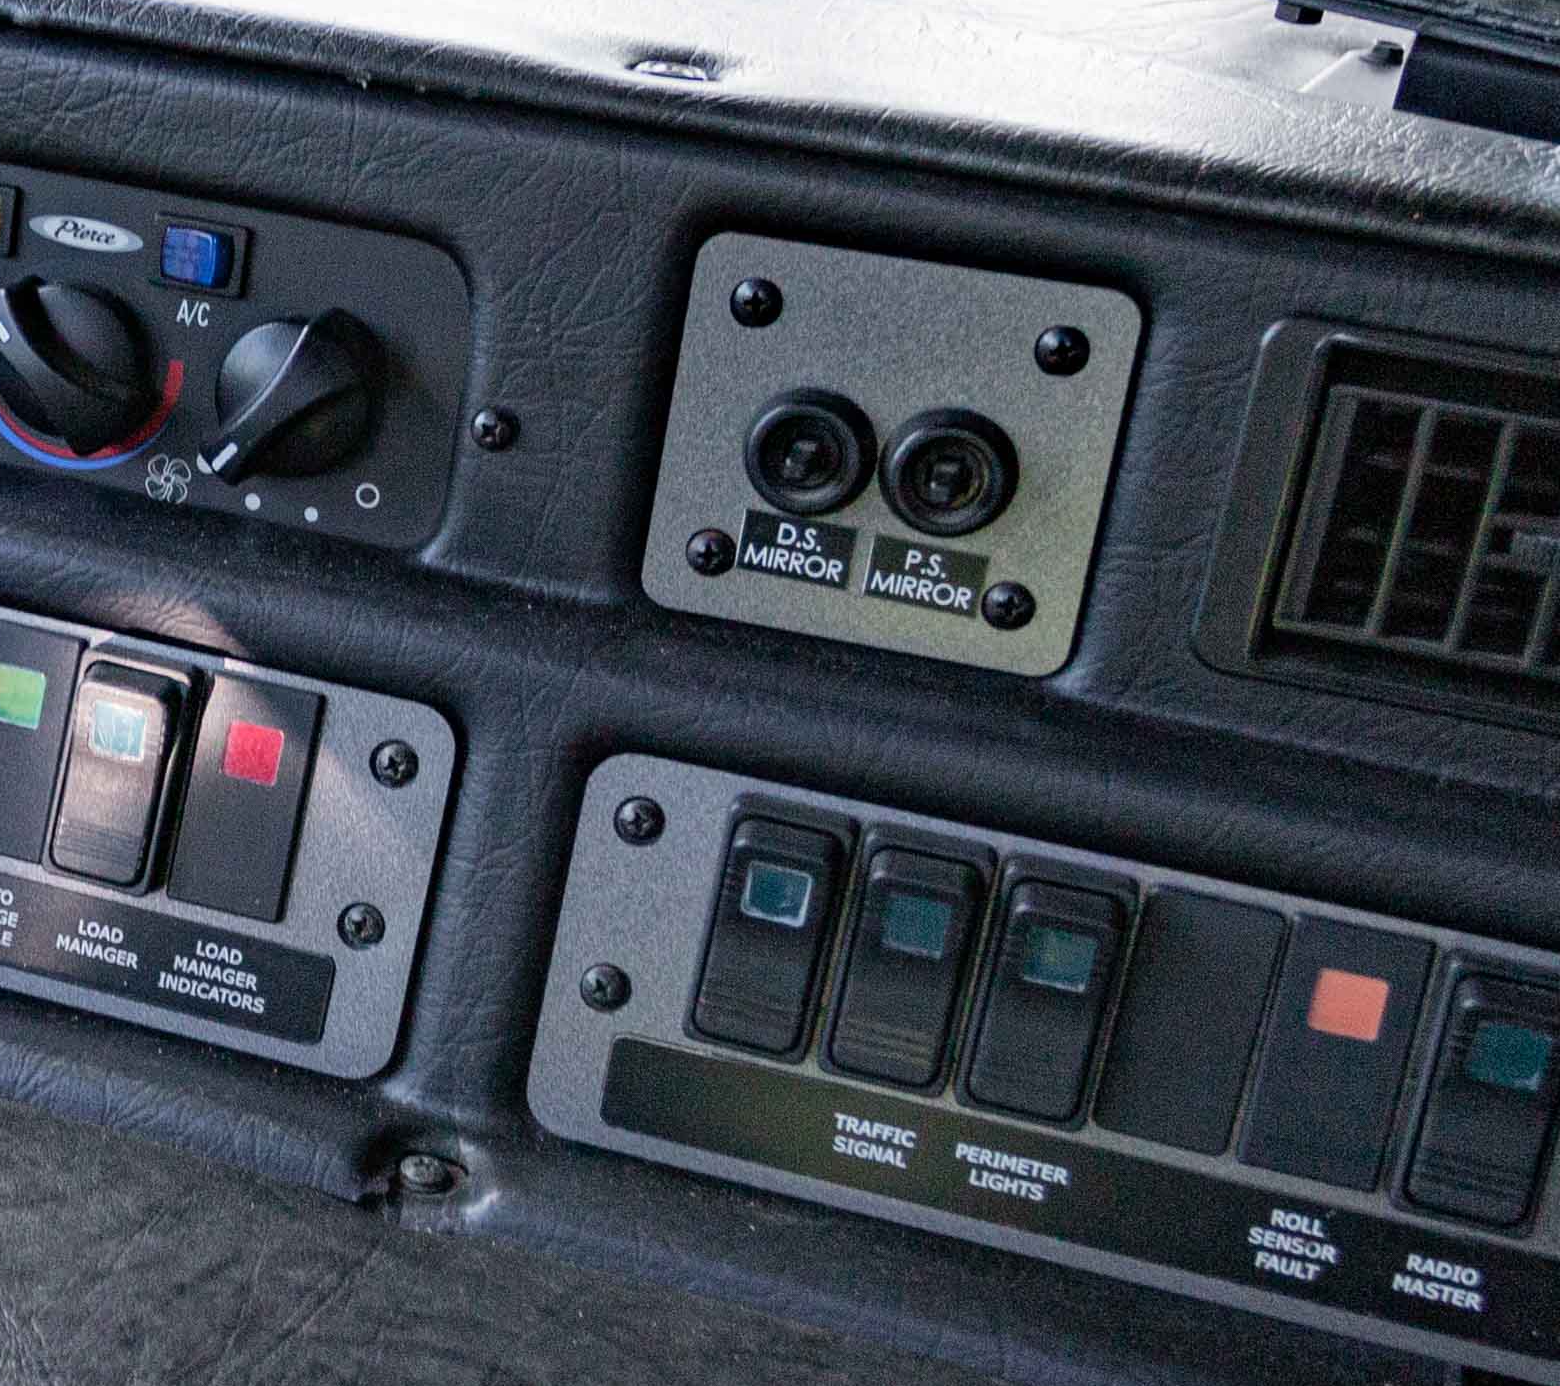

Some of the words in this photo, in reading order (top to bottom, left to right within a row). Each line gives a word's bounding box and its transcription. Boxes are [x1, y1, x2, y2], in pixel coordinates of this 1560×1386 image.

[53, 218, 117, 248] Pierce
[175, 298, 211, 329] A/C
[776, 521, 822, 553] D.S.
[742, 542, 844, 583] MIRROR
[903, 548, 947, 580] P.S.
[869, 570, 973, 611] MIRROR
[77, 918, 126, 946] LOAD
[55, 932, 140, 971] MANAGER
[195, 938, 244, 966] LOAD
[173, 953, 259, 993] MANAGER
[157, 971, 267, 1015] INDICATORS
[832, 1111, 918, 1149] TRAFFIC
[831, 1135, 908, 1170] SIGNAL
[954, 1141, 1069, 1187] PERIMETER
[968, 1168, 1046, 1202] LIGHTS
[1270, 1207, 1326, 1239] ROLL
[1247, 1225, 1339, 1265] SENSOR
[1254, 1250, 1322, 1282] FAULT
[1406, 1253, 1480, 1287] RADIO
[1391, 1272, 1482, 1312] MASTER
